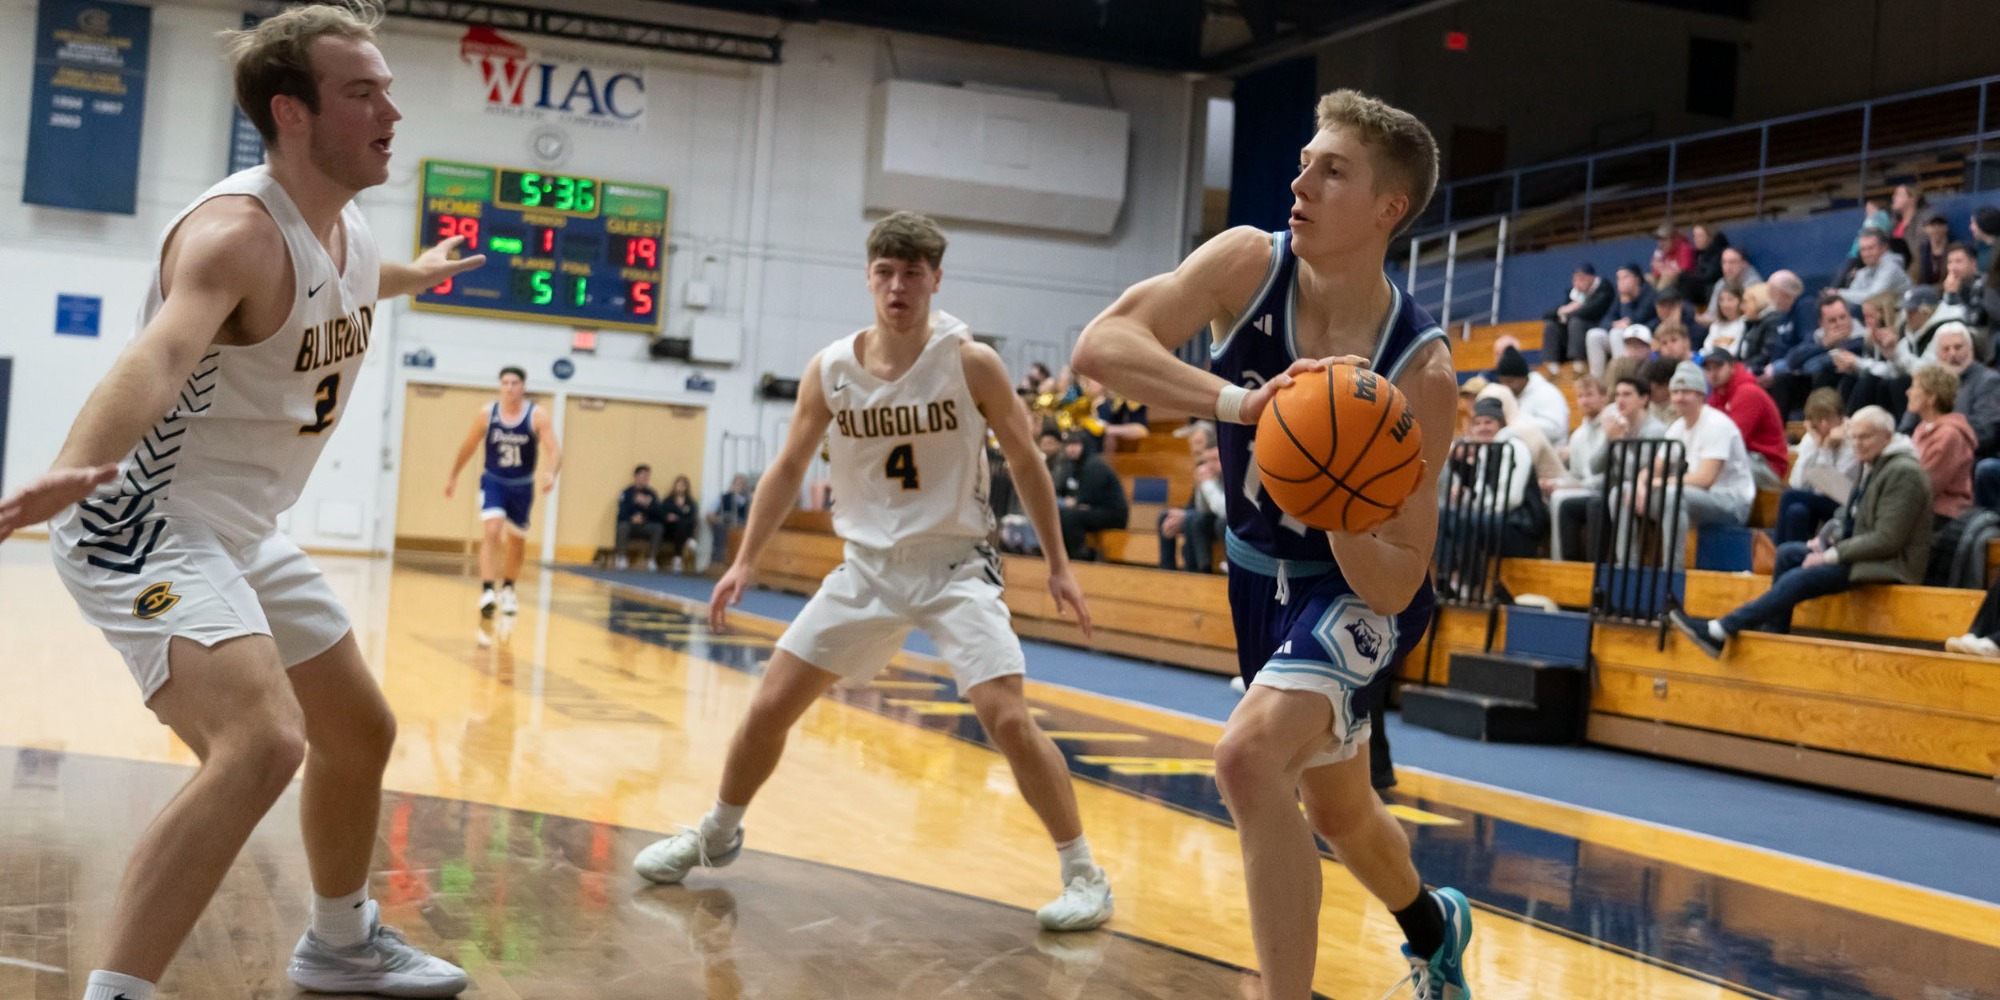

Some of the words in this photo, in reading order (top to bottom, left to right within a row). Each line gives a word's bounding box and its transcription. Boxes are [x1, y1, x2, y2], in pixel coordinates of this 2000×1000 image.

[473, 54, 646, 120] WIAC
[429, 198, 482, 218] HOME
[519, 172, 596, 213] 5:36
[543, 228, 555, 252] 1
[606, 218, 663, 236] GUEST
[626, 237, 657, 269] 19
[531, 270, 553, 305] 5
[575, 277, 587, 307] 1
[632, 280, 653, 315] 5
[294, 302, 376, 372] BLUGOLD
[298, 371, 342, 436] 2
[836, 400, 958, 438] BLUGOLDS
[498, 444, 522, 468] 31
[884, 443, 920, 491] 4
